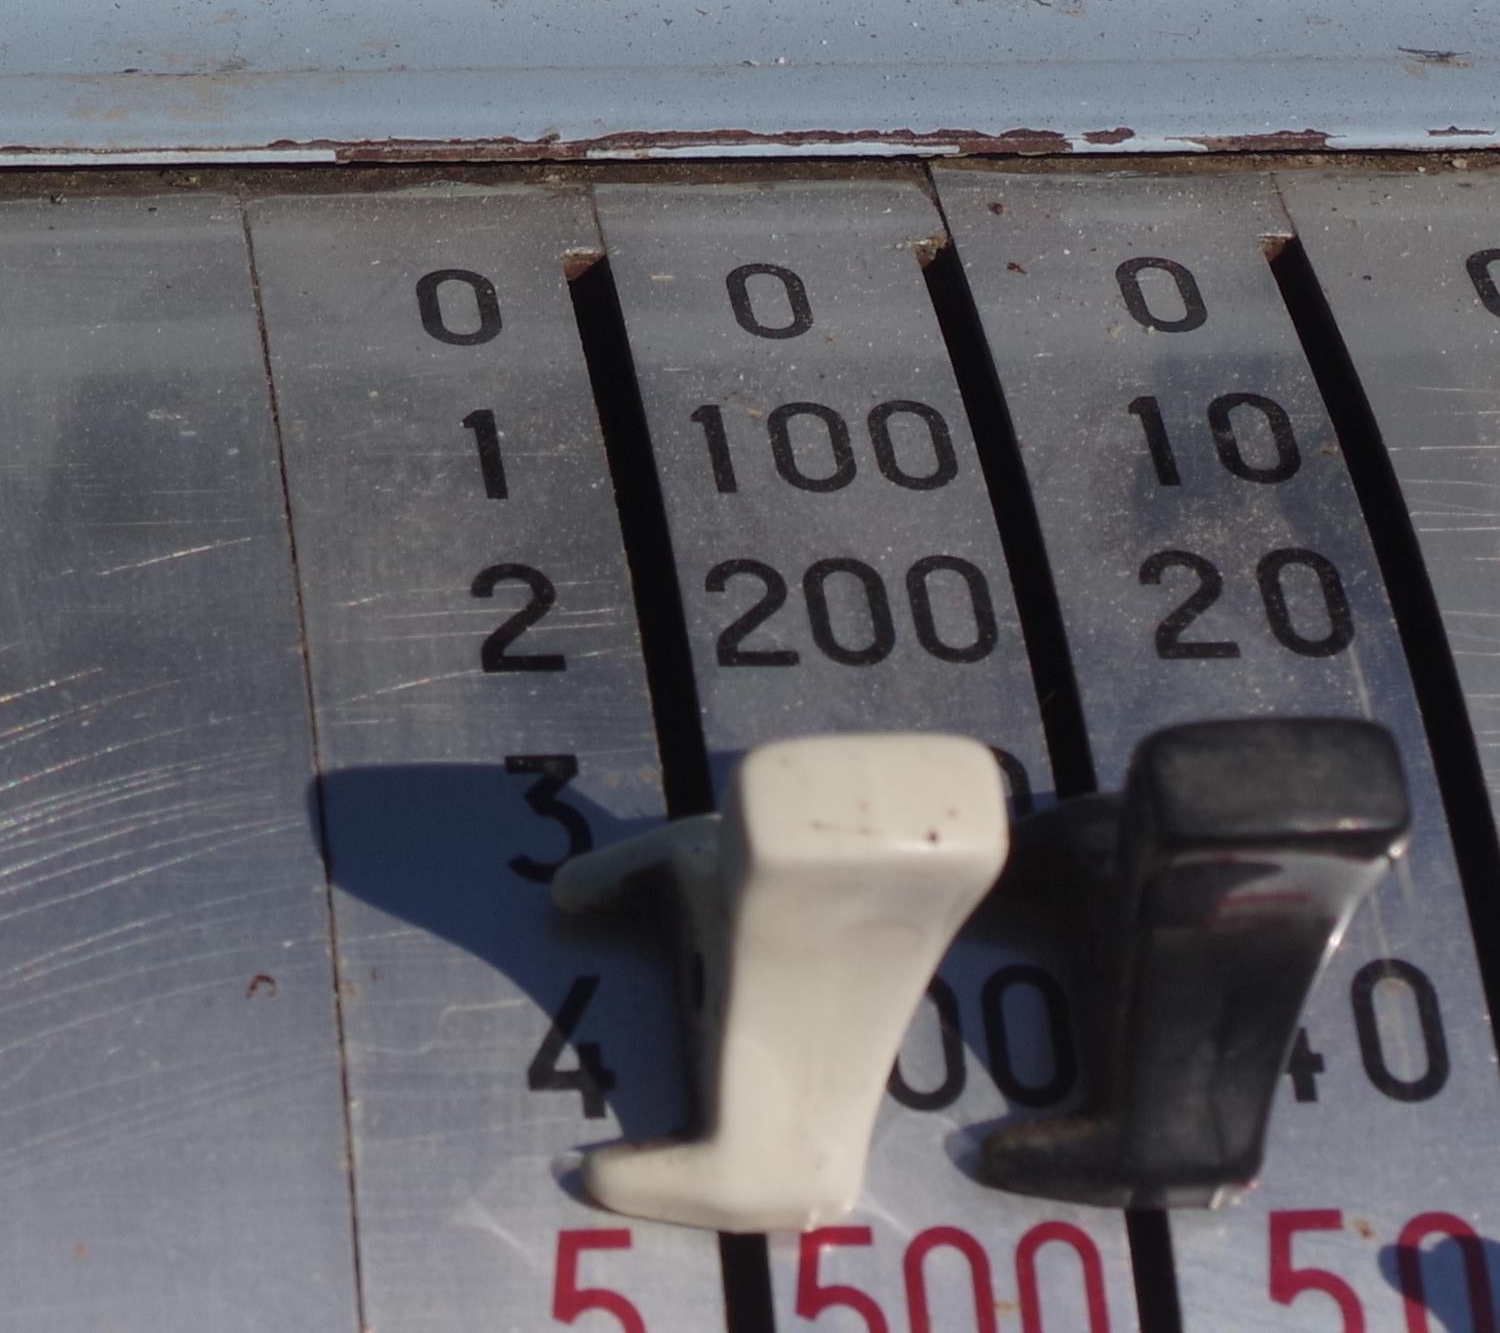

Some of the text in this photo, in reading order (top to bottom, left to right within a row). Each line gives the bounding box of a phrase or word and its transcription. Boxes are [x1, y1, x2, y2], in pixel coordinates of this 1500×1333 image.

[415, 269, 502, 346] 0
[725, 263, 813, 339] 0
[1115, 257, 1207, 332] 0
[461, 409, 508, 500] 1
[690, 400, 958, 493] 100
[1127, 392, 1301, 486] 10
[470, 563, 566, 672] 2
[704, 555, 998, 667] 200
[1138, 547, 1354, 660] 20
[505, 754, 593, 883] 3
[527, 975, 616, 1119] 4
[889, 964, 1078, 1112] 00
[551, 1228, 647, 1333] 5
[794, 1221, 1109, 1333] 500
[1268, 1209, 1496, 1333] 50
